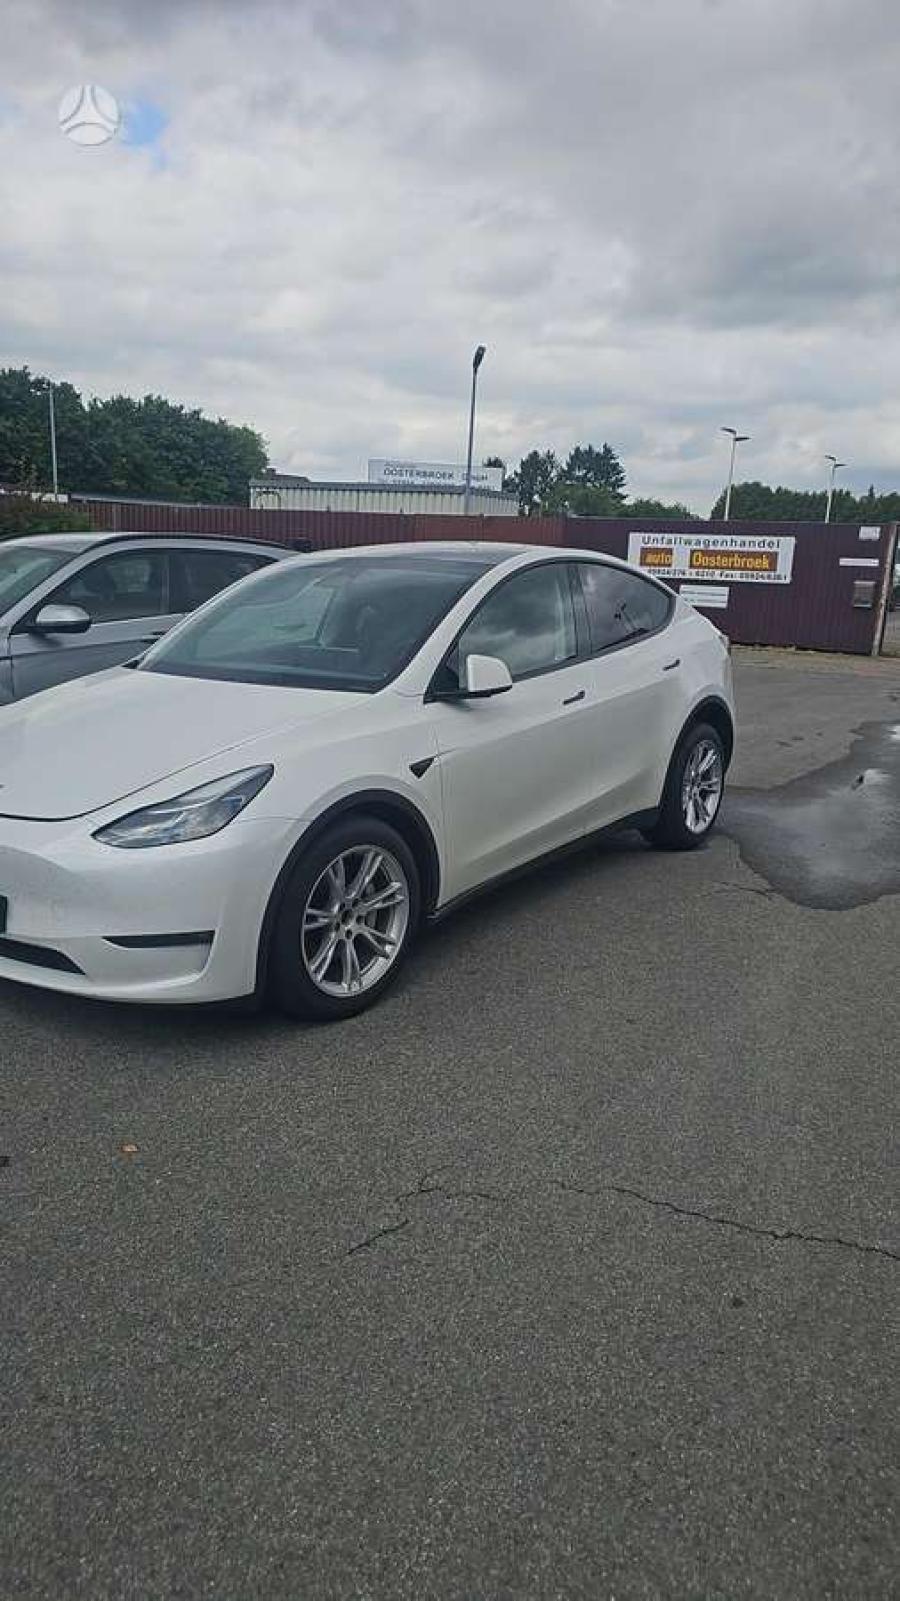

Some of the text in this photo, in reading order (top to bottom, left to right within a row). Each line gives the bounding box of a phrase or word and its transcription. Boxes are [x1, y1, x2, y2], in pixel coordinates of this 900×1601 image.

[641, 535, 780, 549] Unfallwagenhandel
[645, 551, 769, 569] auto Oosterbroek
